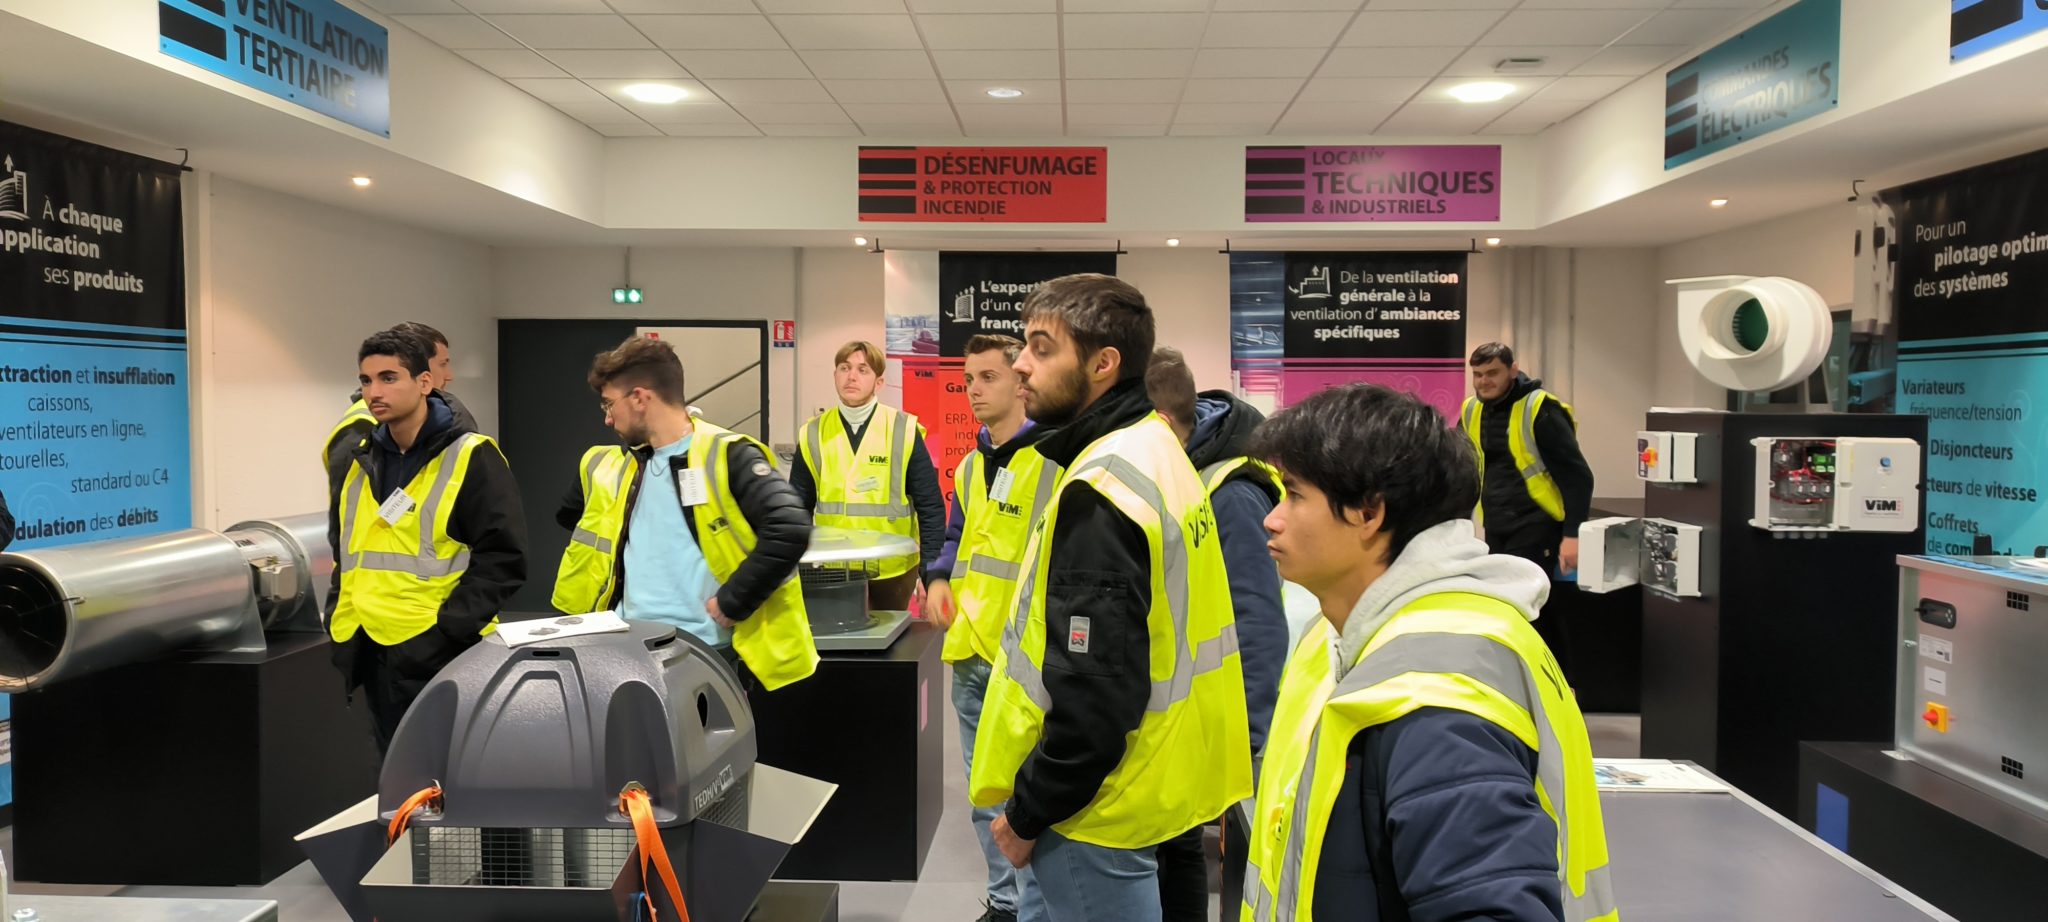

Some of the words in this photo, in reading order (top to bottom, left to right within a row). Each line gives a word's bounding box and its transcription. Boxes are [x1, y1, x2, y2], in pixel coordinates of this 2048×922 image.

[233, 24, 356, 107] TERTIAIRE
[924, 152, 1097, 176] DÉSENFUMAGE
[923, 181, 936, 195] &
[941, 181, 1052, 195] PROTECTION
[1312, 171, 1494, 196] TECHNIQUES
[42, 195, 55, 221] À
[59, 203, 123, 235] chaque
[924, 200, 1006, 215] INCENDIE
[1312, 200, 1324, 214] &
[1330, 199, 1447, 214] INDUSTRIELS
[1916, 223, 1945, 243] Pour
[1948, 220, 1966, 237] un
[1935, 243, 1998, 272] pilotage
[44, 267, 70, 285] ses
[74, 269, 144, 293] produits
[1340, 271, 1359, 284] De
[1362, 270, 1373, 284] la
[1376, 270, 1458, 284] ventilation
[1914, 278, 1936, 297] des
[1939, 271, 2009, 299] systèmes
[980, 298, 1011, 311] d'un
[1339, 289, 1405, 305] générale
[1408, 289, 1416, 302] à
[1419, 289, 1431, 302] la
[1290, 307, 1362, 320] ventilation
[1380, 307, 1461, 320] ambiances
[1314, 325, 1400, 341] spécifiques
[76, 368, 91, 384] et
[94, 366, 175, 386] insufflation
[1902, 379, 1965, 396] Variateurs
[28, 393, 94, 413] caissons,
[1910, 403, 2022, 423] fréquence/tension
[0, 420, 87, 441] ventilateurs
[91, 423, 108, 438] en
[112, 419, 146, 441] ligne,
[0, 448, 69, 470] tourelles,
[1931, 438, 2013, 461] Disjoncteurs
[71, 469, 131, 494] standard
[135, 476, 150, 488] ou
[152, 468, 169, 485] C4
[1966, 478, 1982, 496] de
[1985, 481, 2037, 502] vitesse
[15, 517, 86, 541] dulation
[90, 513, 114, 531] des
[117, 507, 159, 528] débits
[1928, 511, 1978, 534] Coffrets
[1927, 536, 1942, 553] de
